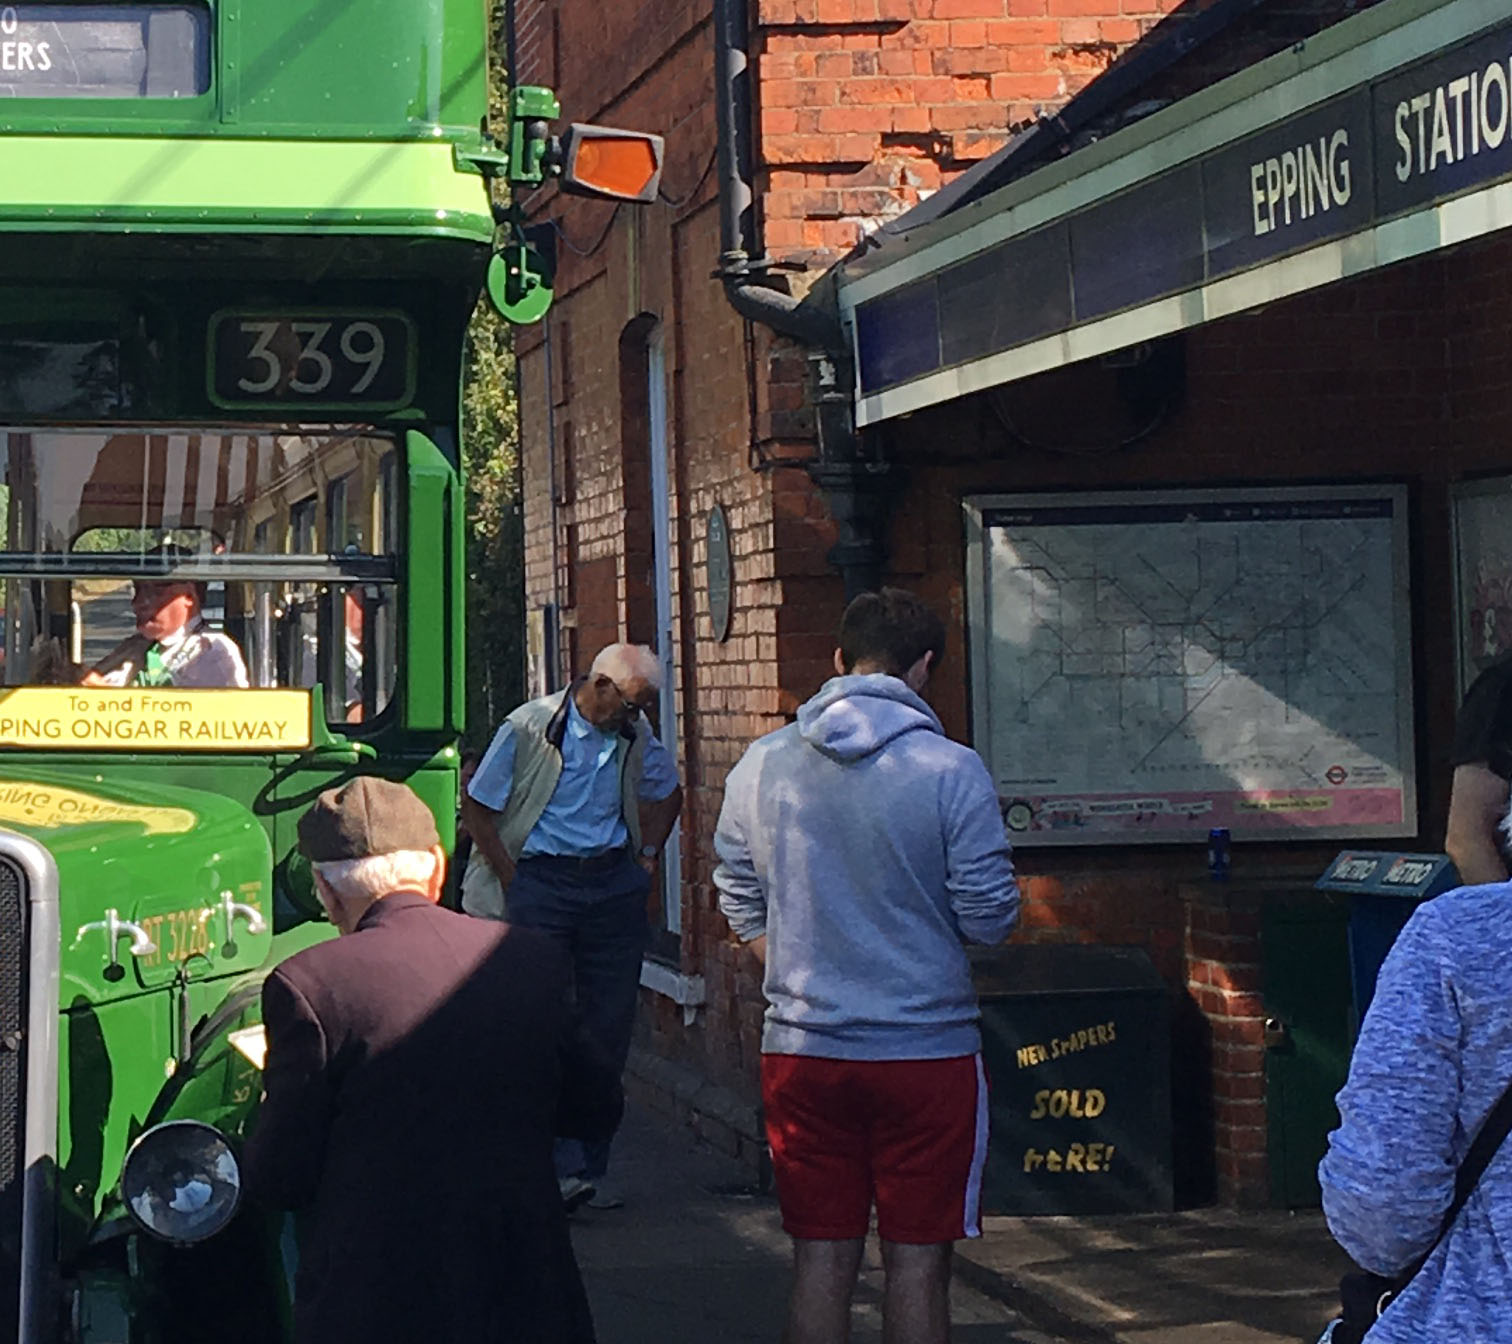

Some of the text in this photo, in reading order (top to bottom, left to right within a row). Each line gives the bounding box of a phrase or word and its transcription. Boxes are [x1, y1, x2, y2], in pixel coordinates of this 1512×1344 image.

[1251, 56, 1511, 236] EPPING STATIO
[238, 321, 385, 393] 339
[69, 695, 192, 713] To and From
[71, 719, 169, 740] ONGAR
[179, 720, 288, 741] RAILWAY
[1030, 1088, 1106, 1119] SOLD
